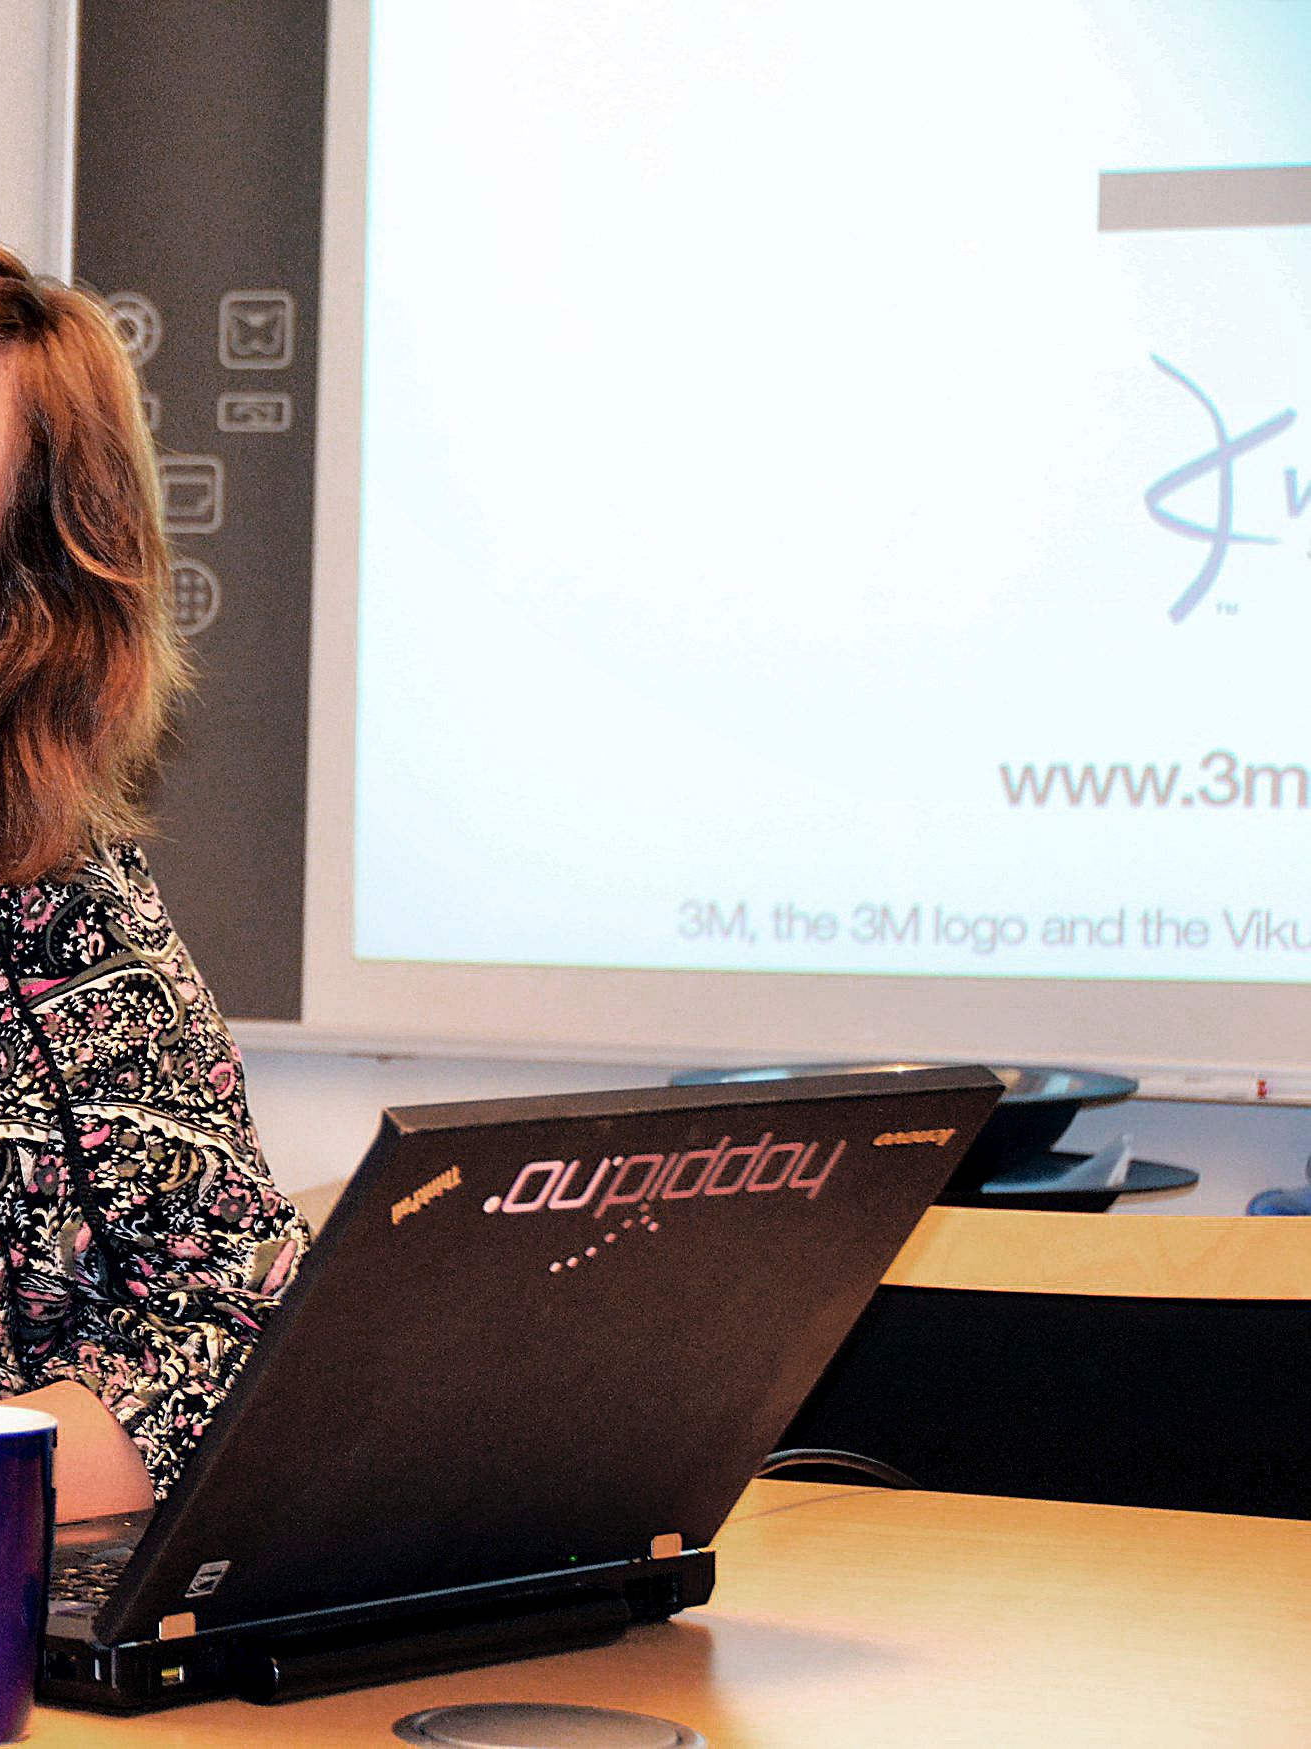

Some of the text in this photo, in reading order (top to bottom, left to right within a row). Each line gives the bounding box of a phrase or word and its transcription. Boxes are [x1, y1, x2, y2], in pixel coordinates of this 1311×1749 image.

[999, 751, 1310, 807] www.3m
[678, 900, 756, 944] 3M,
[771, 903, 839, 943] the
[850, 903, 921, 944] 3M
[933, 905, 1028, 956] logo
[1041, 907, 1126, 948] and
[1139, 909, 1211, 949] the
